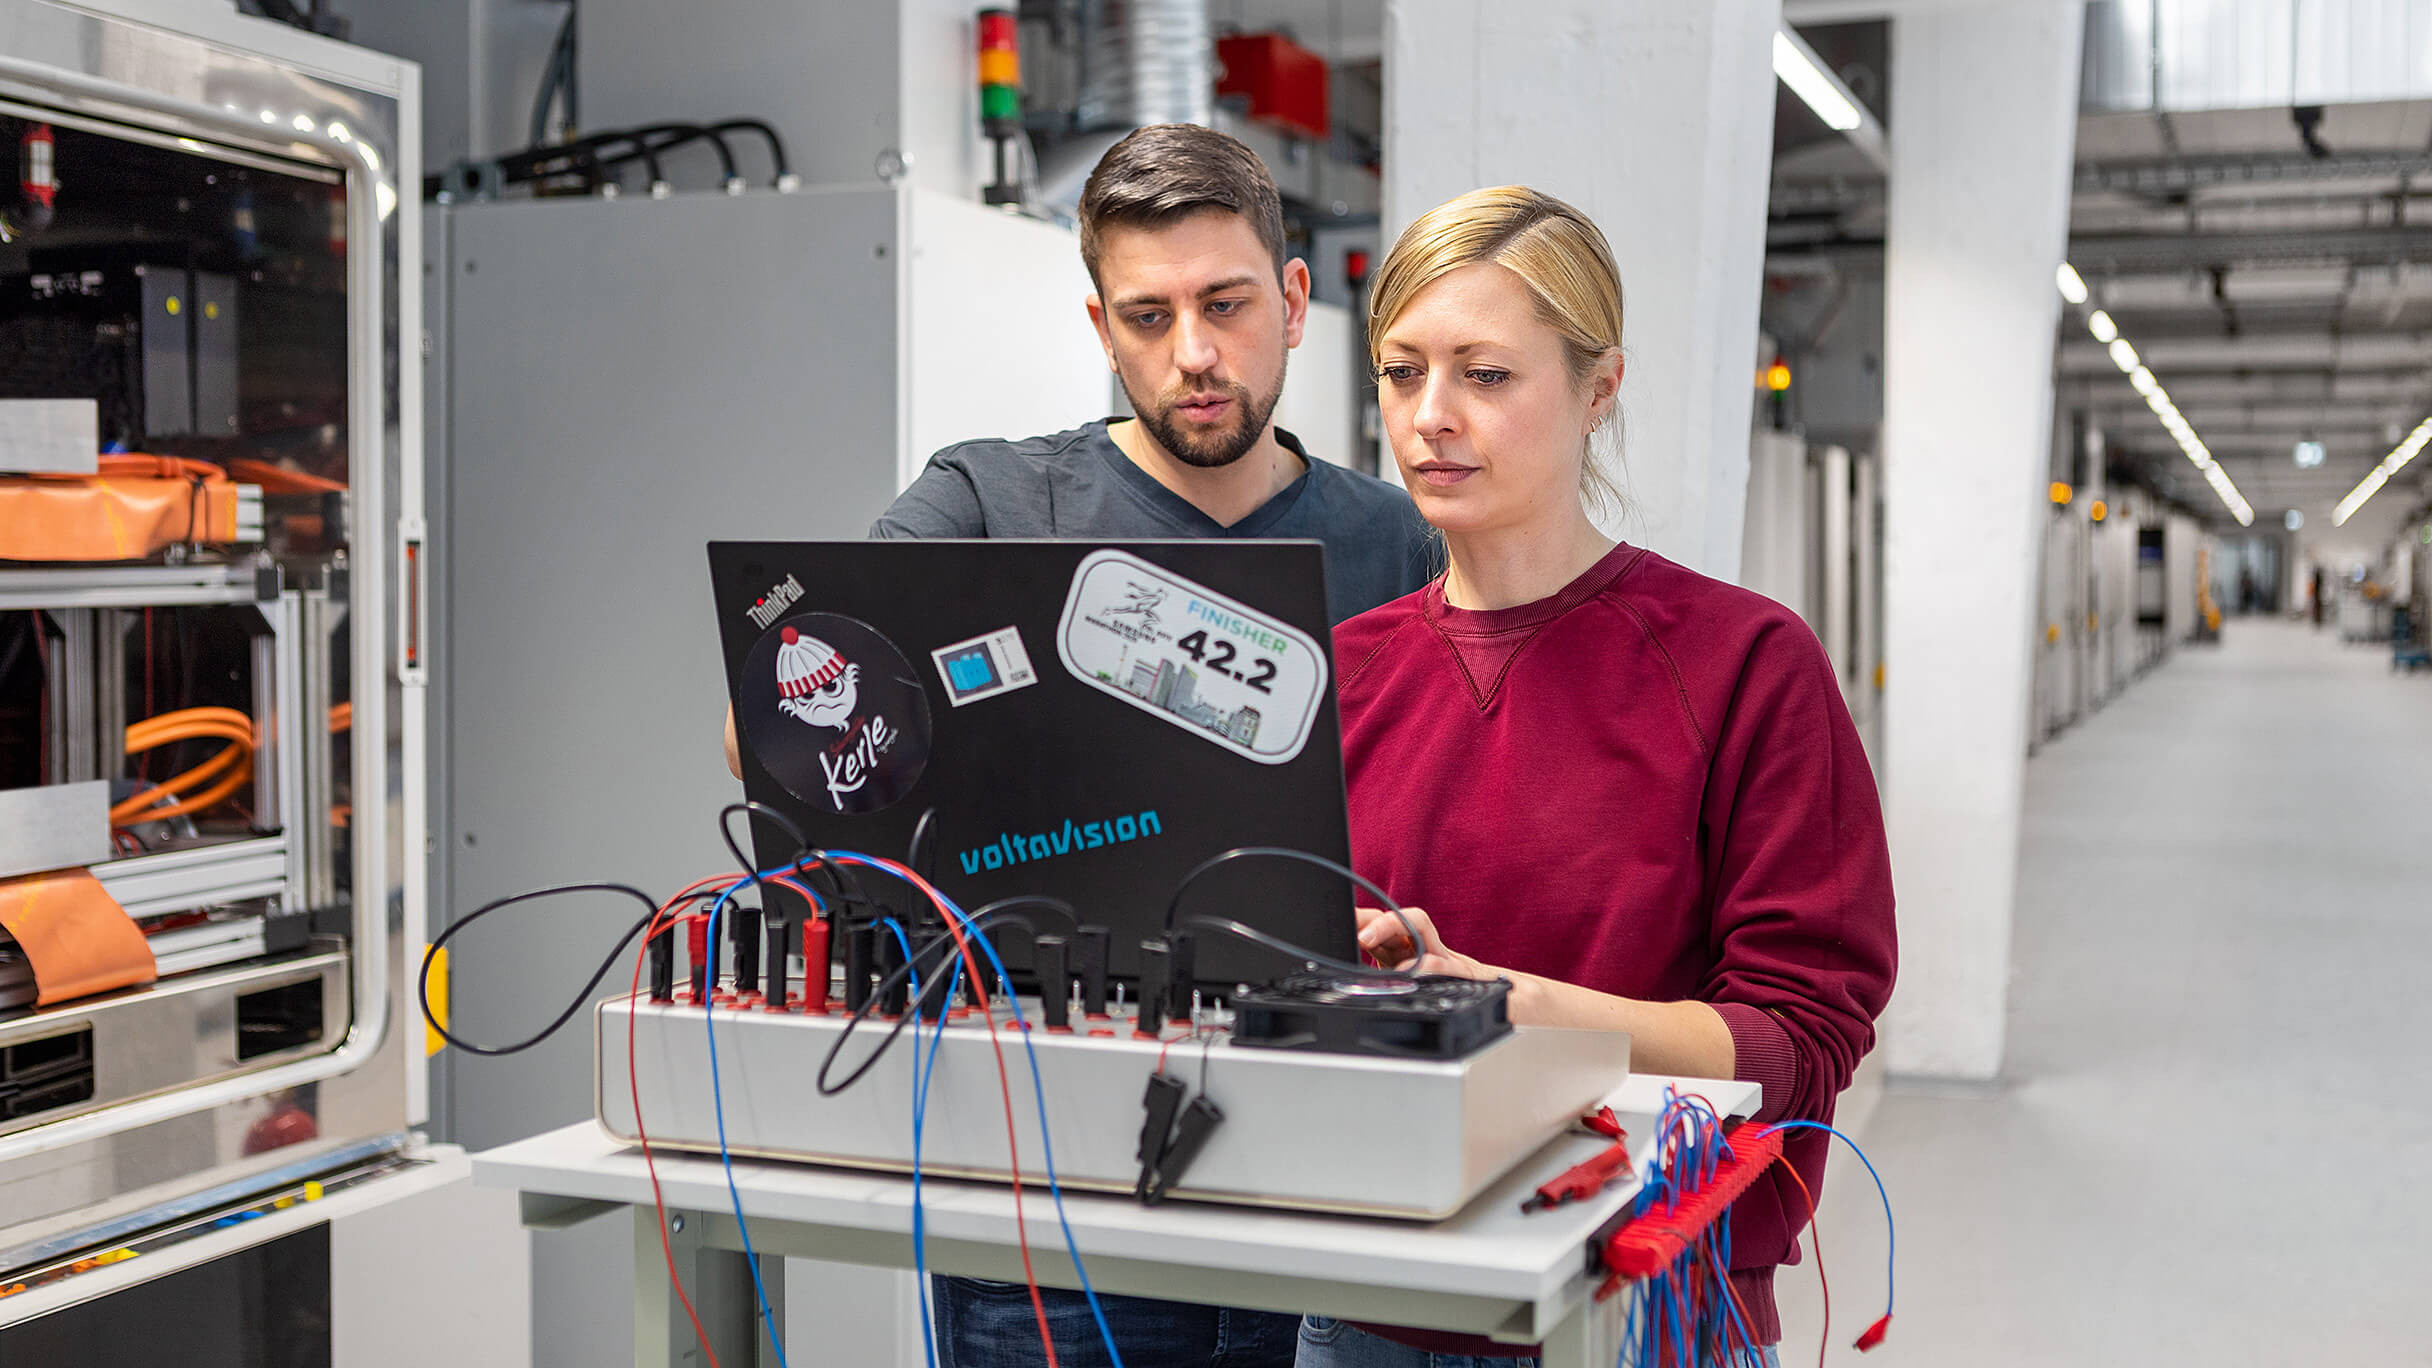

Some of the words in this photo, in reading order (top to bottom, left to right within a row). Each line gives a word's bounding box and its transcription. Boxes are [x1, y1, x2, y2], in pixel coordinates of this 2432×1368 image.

[746, 573, 806, 630] ThinkPad
[1187, 599, 1288, 656] FINISHER
[1177, 630, 1278, 696] 42.2
[818, 715, 888, 811] Kerle
[959, 810, 1163, 875] voltavision
